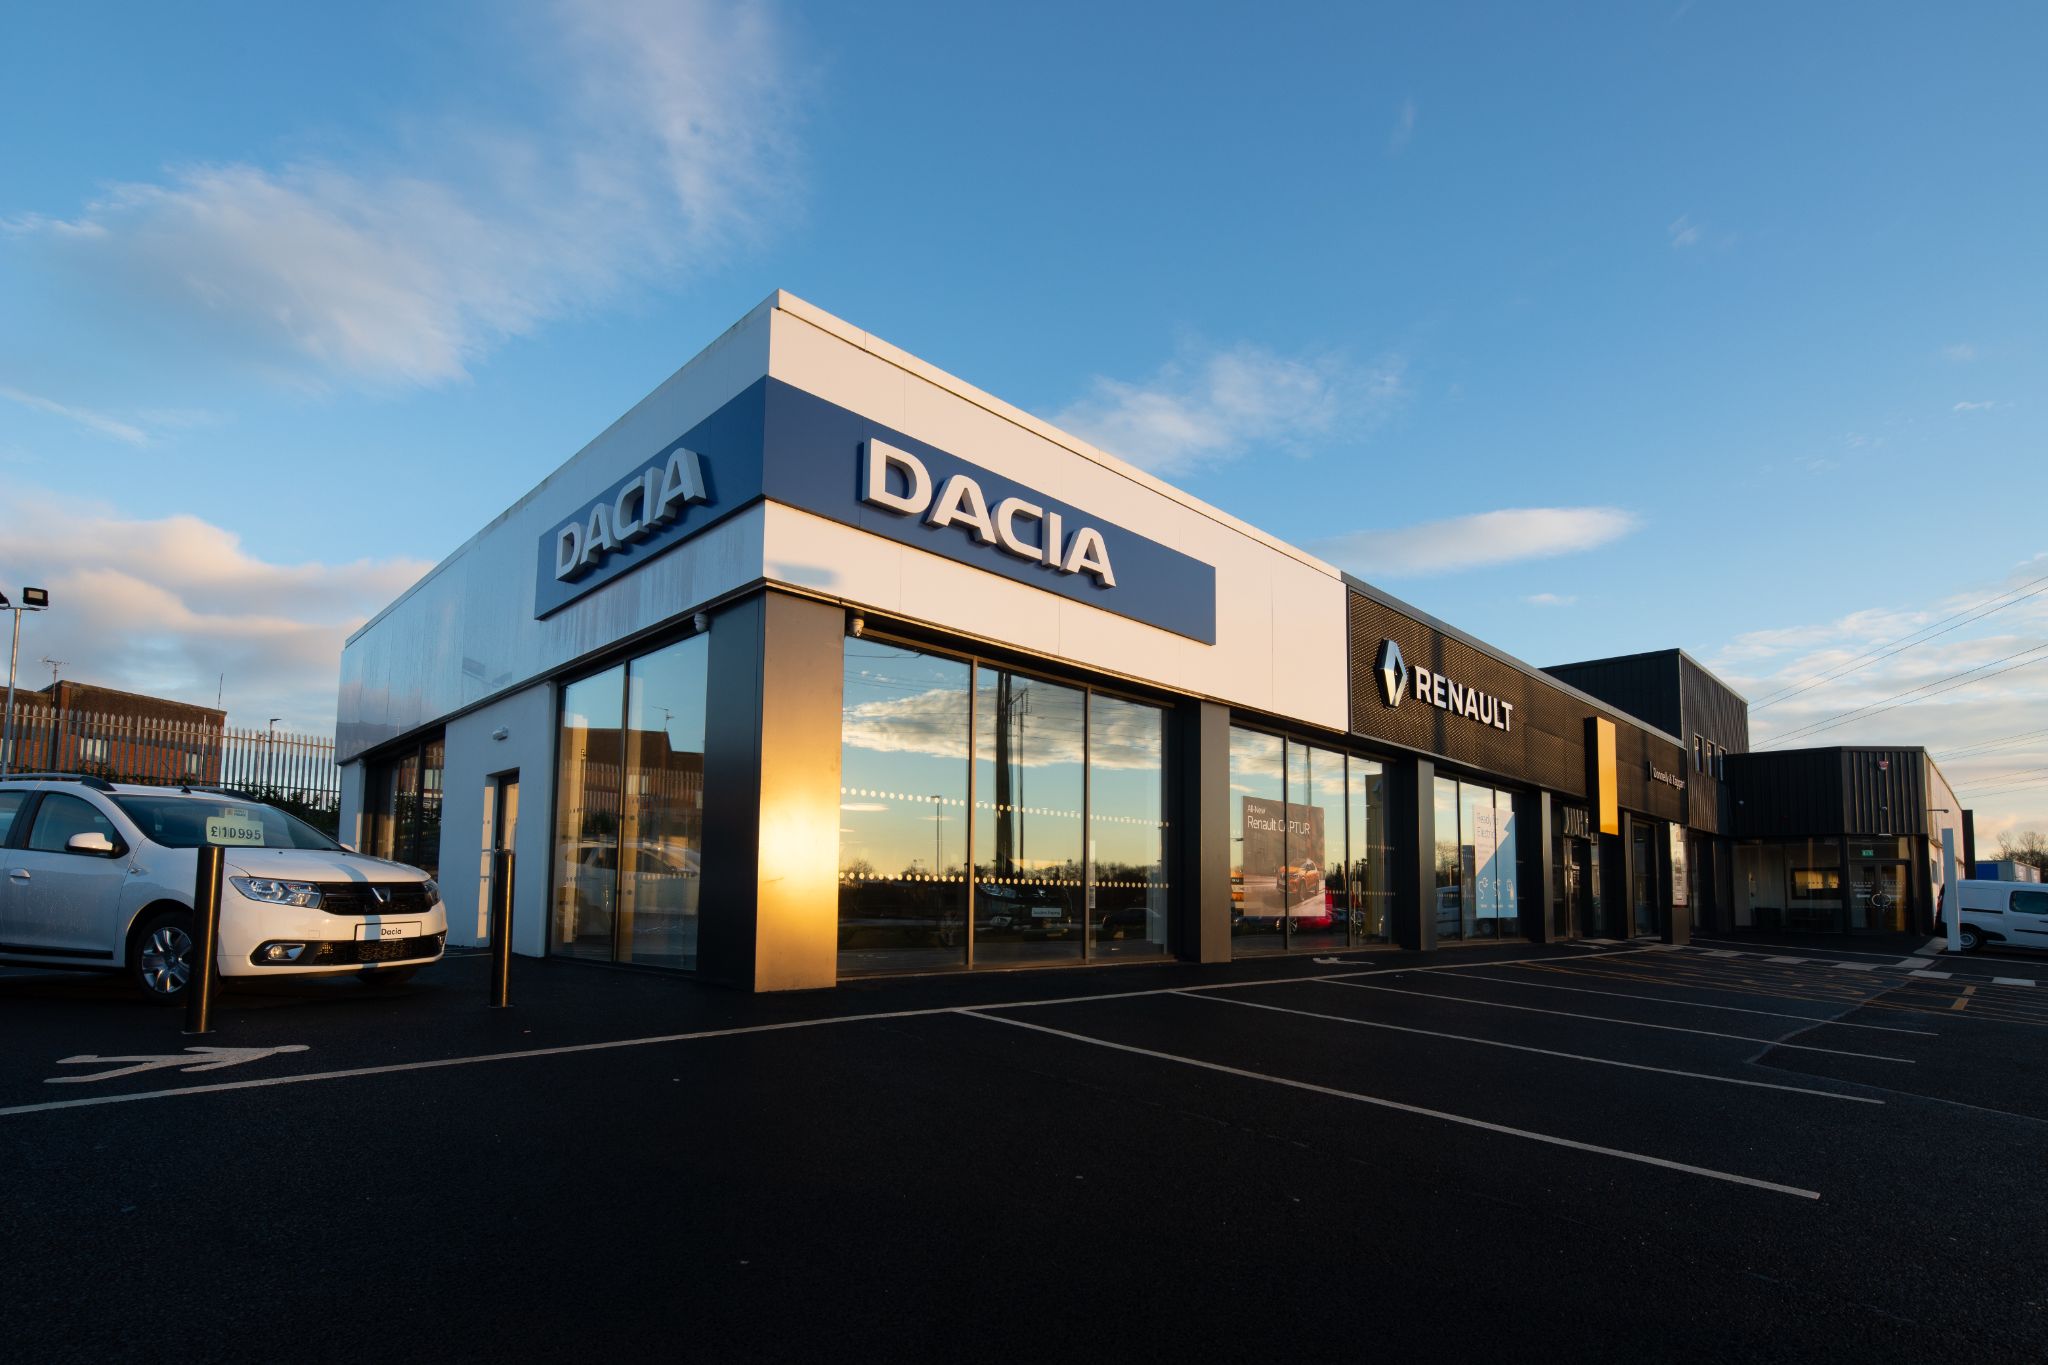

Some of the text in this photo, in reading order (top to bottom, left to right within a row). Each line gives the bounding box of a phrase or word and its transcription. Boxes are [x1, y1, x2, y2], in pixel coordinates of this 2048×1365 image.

[555, 447, 707, 585] DACIA
[862, 437, 1117, 589] DACIA
[1414, 665, 1514, 733] RENAULT
[210, 825, 262, 841] £10995
[1247, 815, 1311, 835] Renault CPTUR
[380, 927, 402, 936] Dacia
